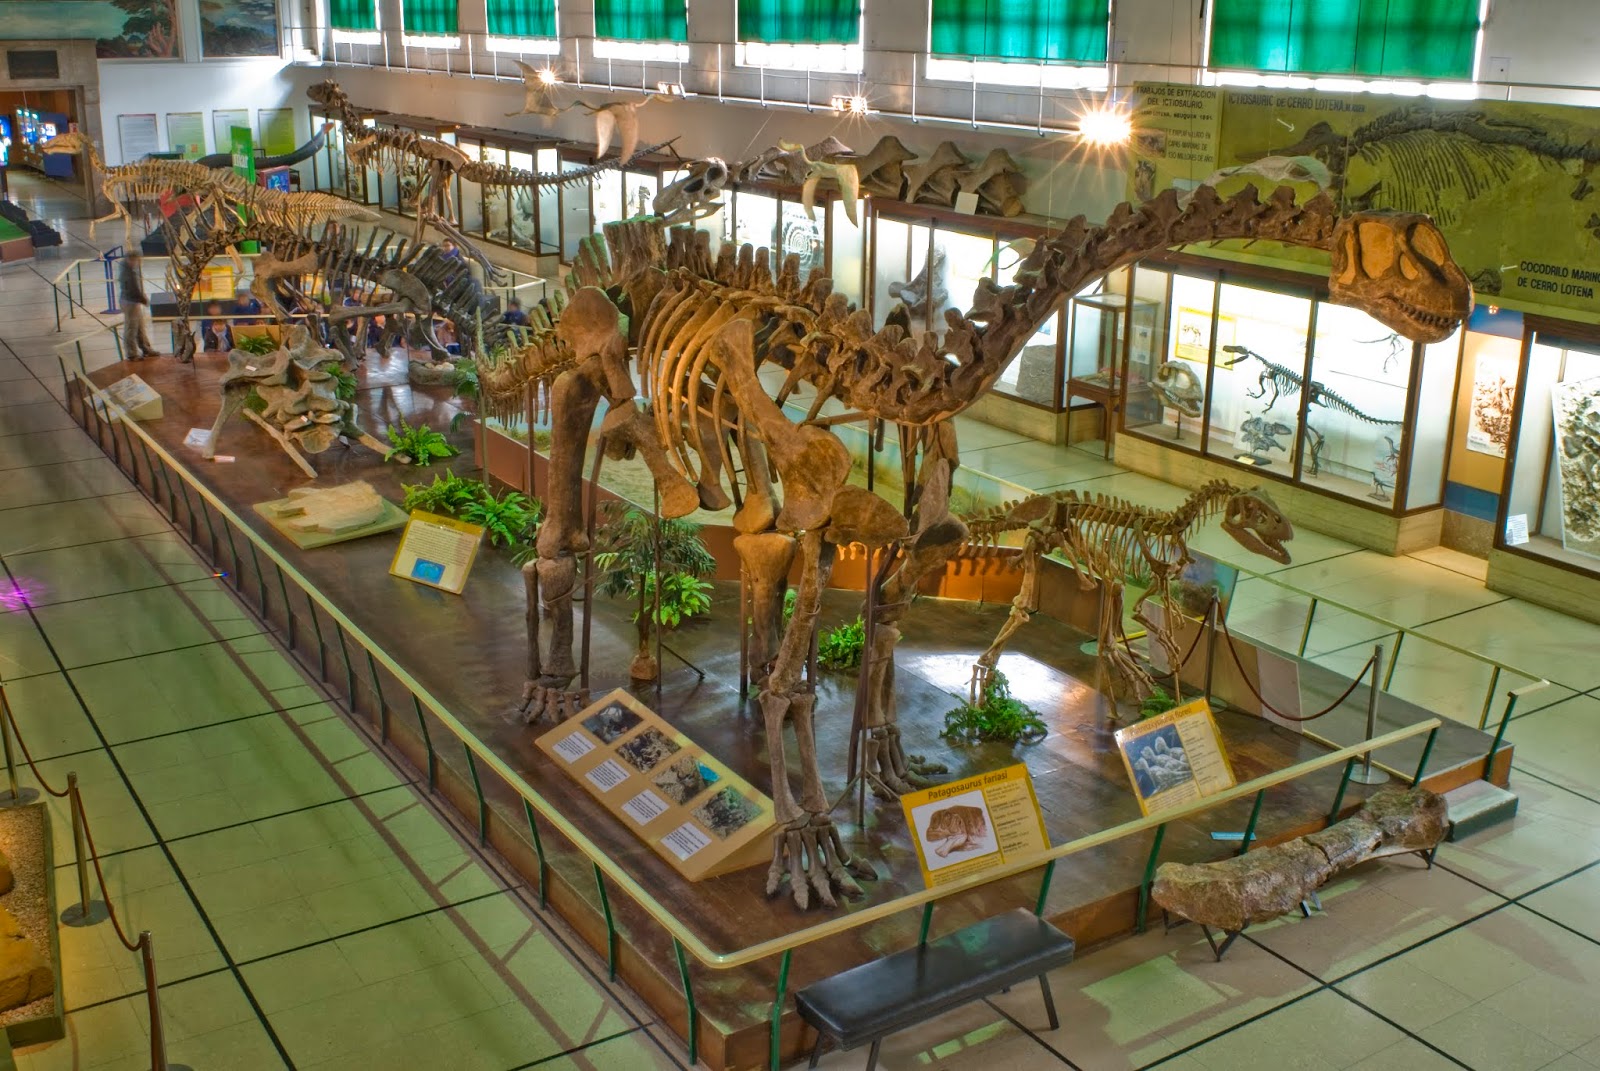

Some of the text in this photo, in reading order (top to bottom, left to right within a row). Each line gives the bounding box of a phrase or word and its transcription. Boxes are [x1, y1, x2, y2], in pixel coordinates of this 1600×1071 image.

[1167, 88, 1175, 97] DE
[1147, 97, 1159, 106] DEL
[1287, 96, 1313, 110] CERRO
[1520, 261, 1569, 278] COCODRILO
[1517, 276, 1594, 299] DE CERRO LOTENA
[928, 769, 1008, 800] Patagosaurus fariasi
